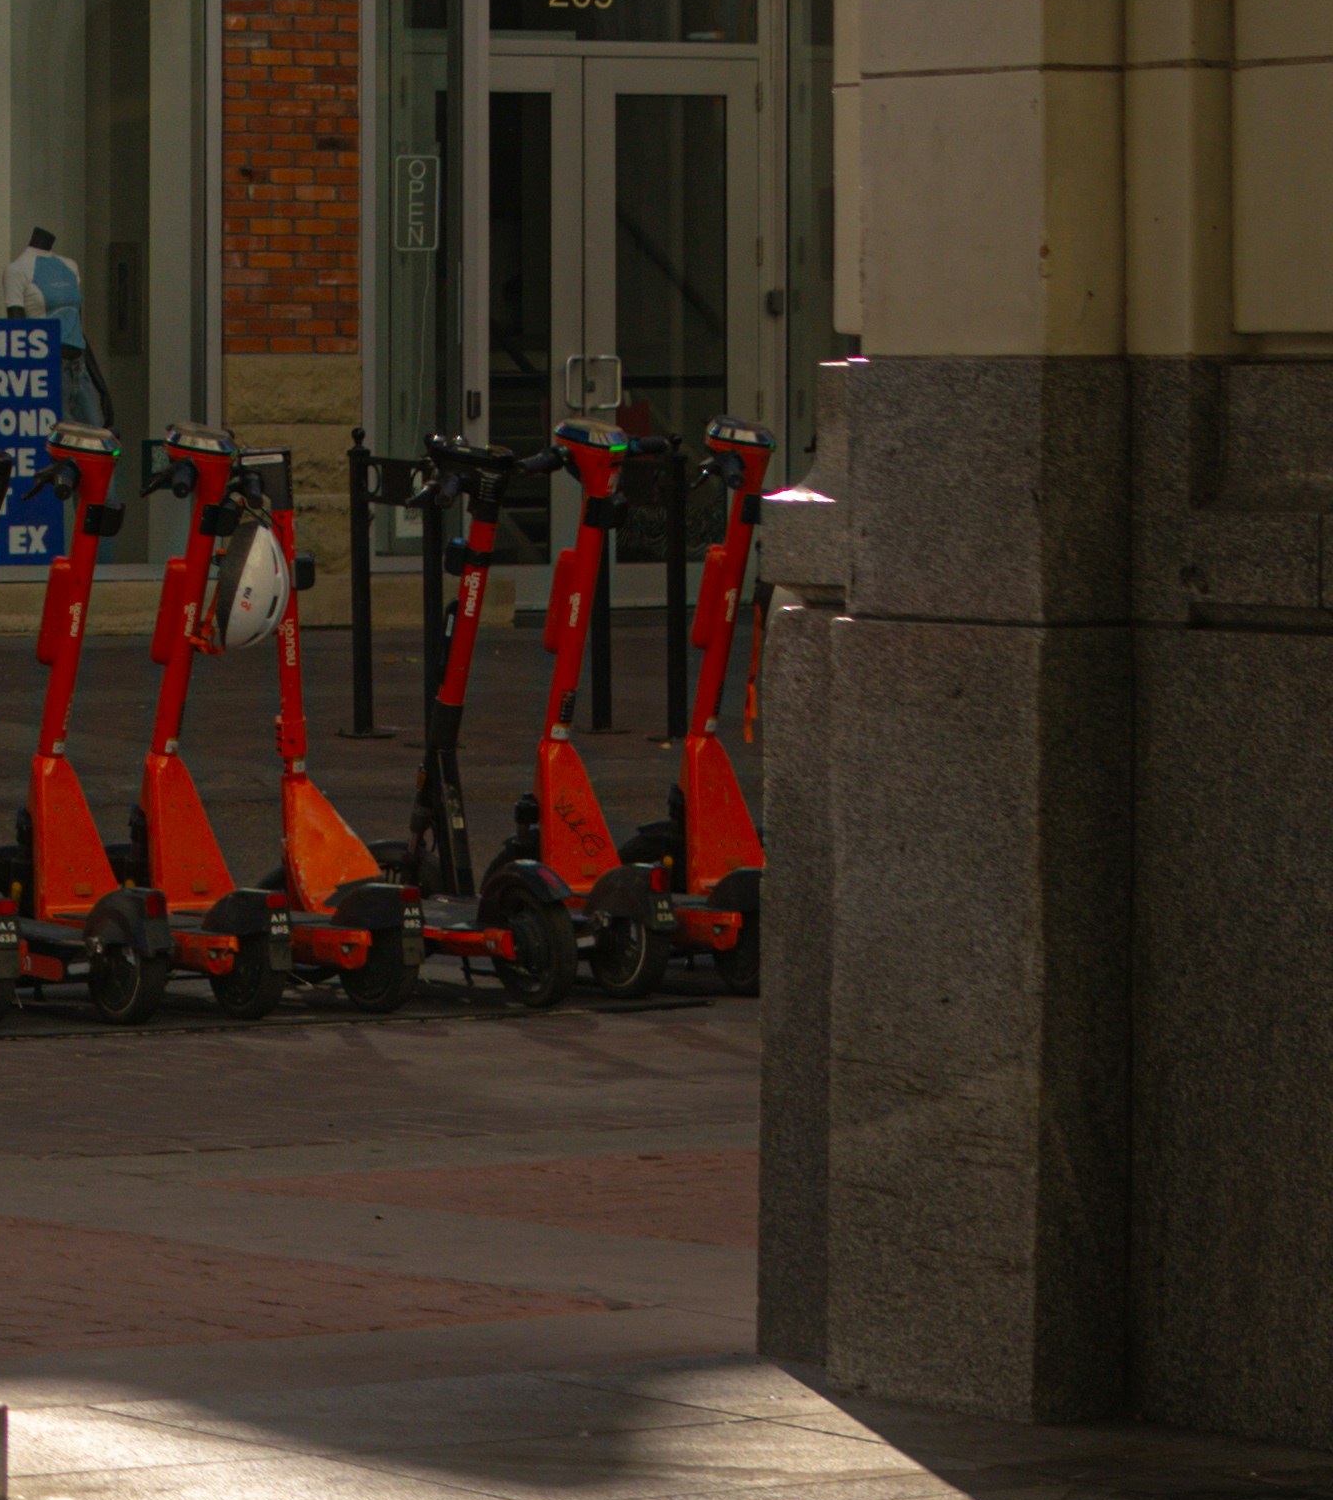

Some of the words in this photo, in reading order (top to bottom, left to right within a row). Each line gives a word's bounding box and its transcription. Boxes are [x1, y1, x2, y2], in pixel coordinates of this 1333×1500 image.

[408, 159, 426, 247] OPEN
[8, 525, 49, 555] EX
[464, 571, 481, 618] neuron
[285, 618, 297, 667] neuron
